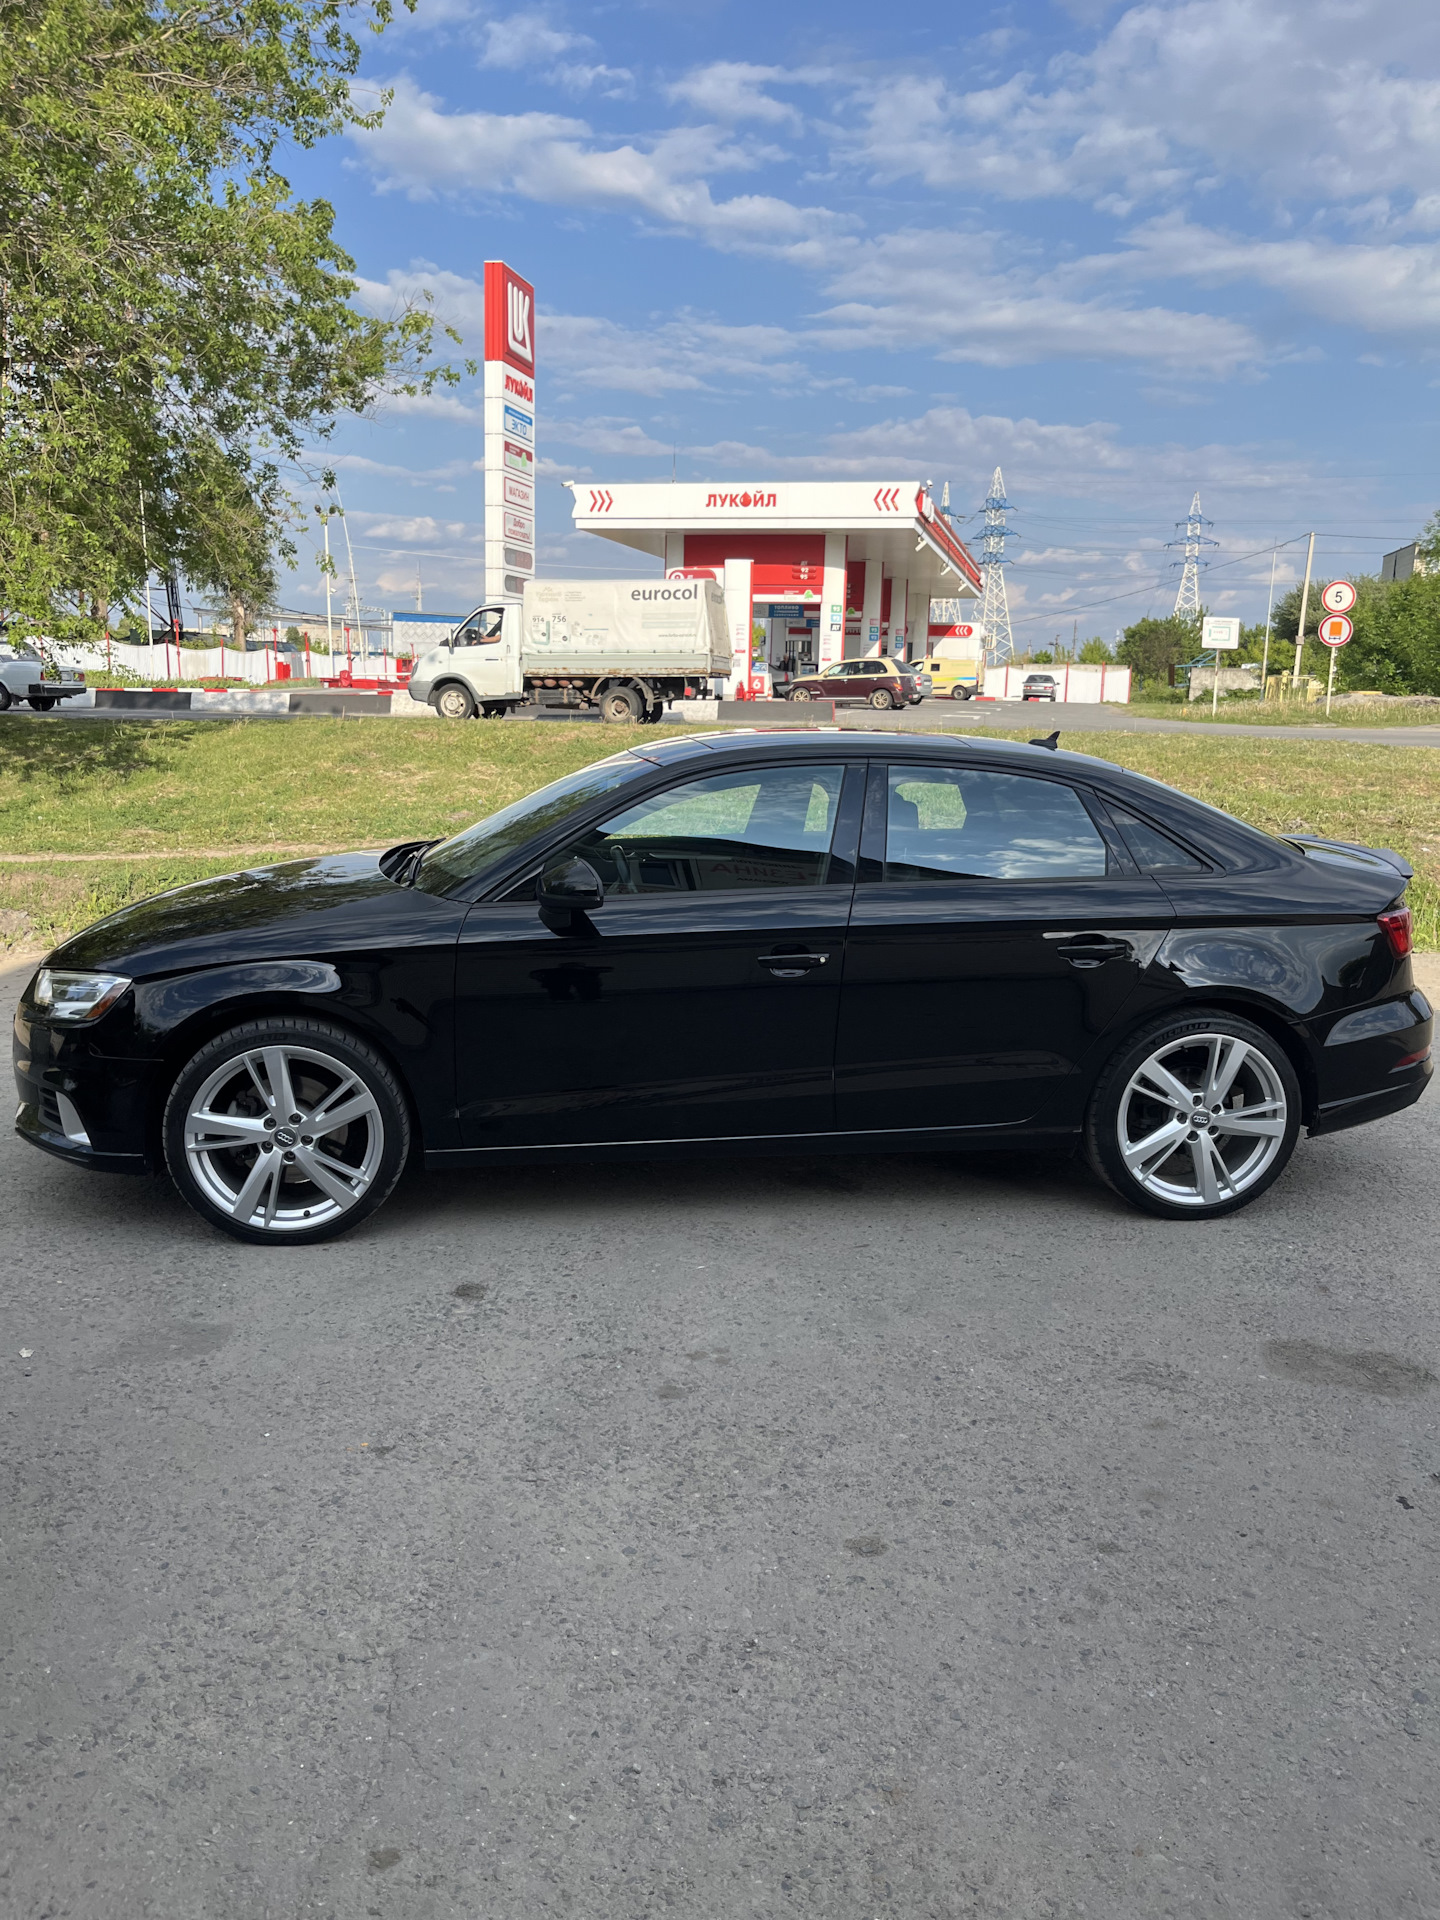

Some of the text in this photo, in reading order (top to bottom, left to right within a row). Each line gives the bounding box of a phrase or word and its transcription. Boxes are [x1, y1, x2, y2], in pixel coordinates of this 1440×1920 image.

[511, 418, 527, 436] ЭКТО
[508, 486, 530, 502] МАГАЗИН
[705, 490, 777, 508] ЛУКОЙЛ
[631, 583, 698, 601] eurocol
[1335, 591, 1343, 604] 5
[552, 615, 567, 623] 756
[752, 679, 762, 690] 6
